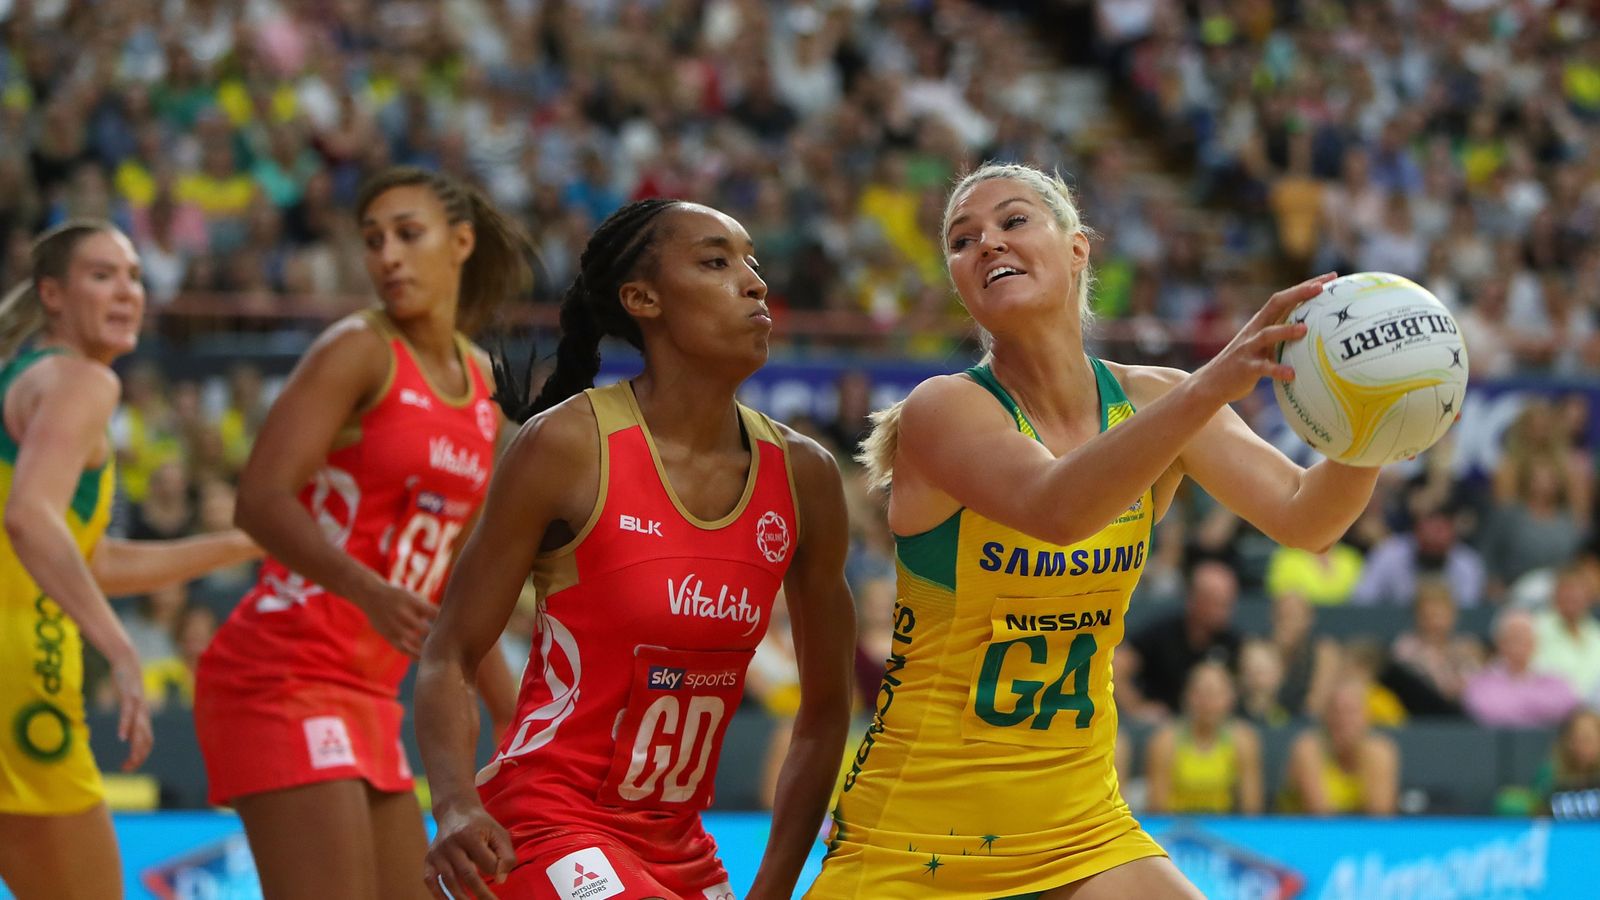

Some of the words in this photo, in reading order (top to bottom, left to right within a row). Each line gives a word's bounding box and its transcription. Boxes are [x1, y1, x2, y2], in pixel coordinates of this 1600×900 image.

[1340, 315, 1457, 361] GILBERT
[620, 514, 664, 537] BLK
[979, 540, 1145, 577] SAMSUNG
[668, 573, 761, 636] Vitality
[1005, 608, 1112, 632] NISSAN
[651, 668, 682, 689] sky
[684, 672, 737, 689] sports
[974, 633, 1098, 731] GA
[617, 695, 725, 803] GD
[571, 877, 609, 898] MITSUBISHI
[579, 885, 607, 900] MOTORS
